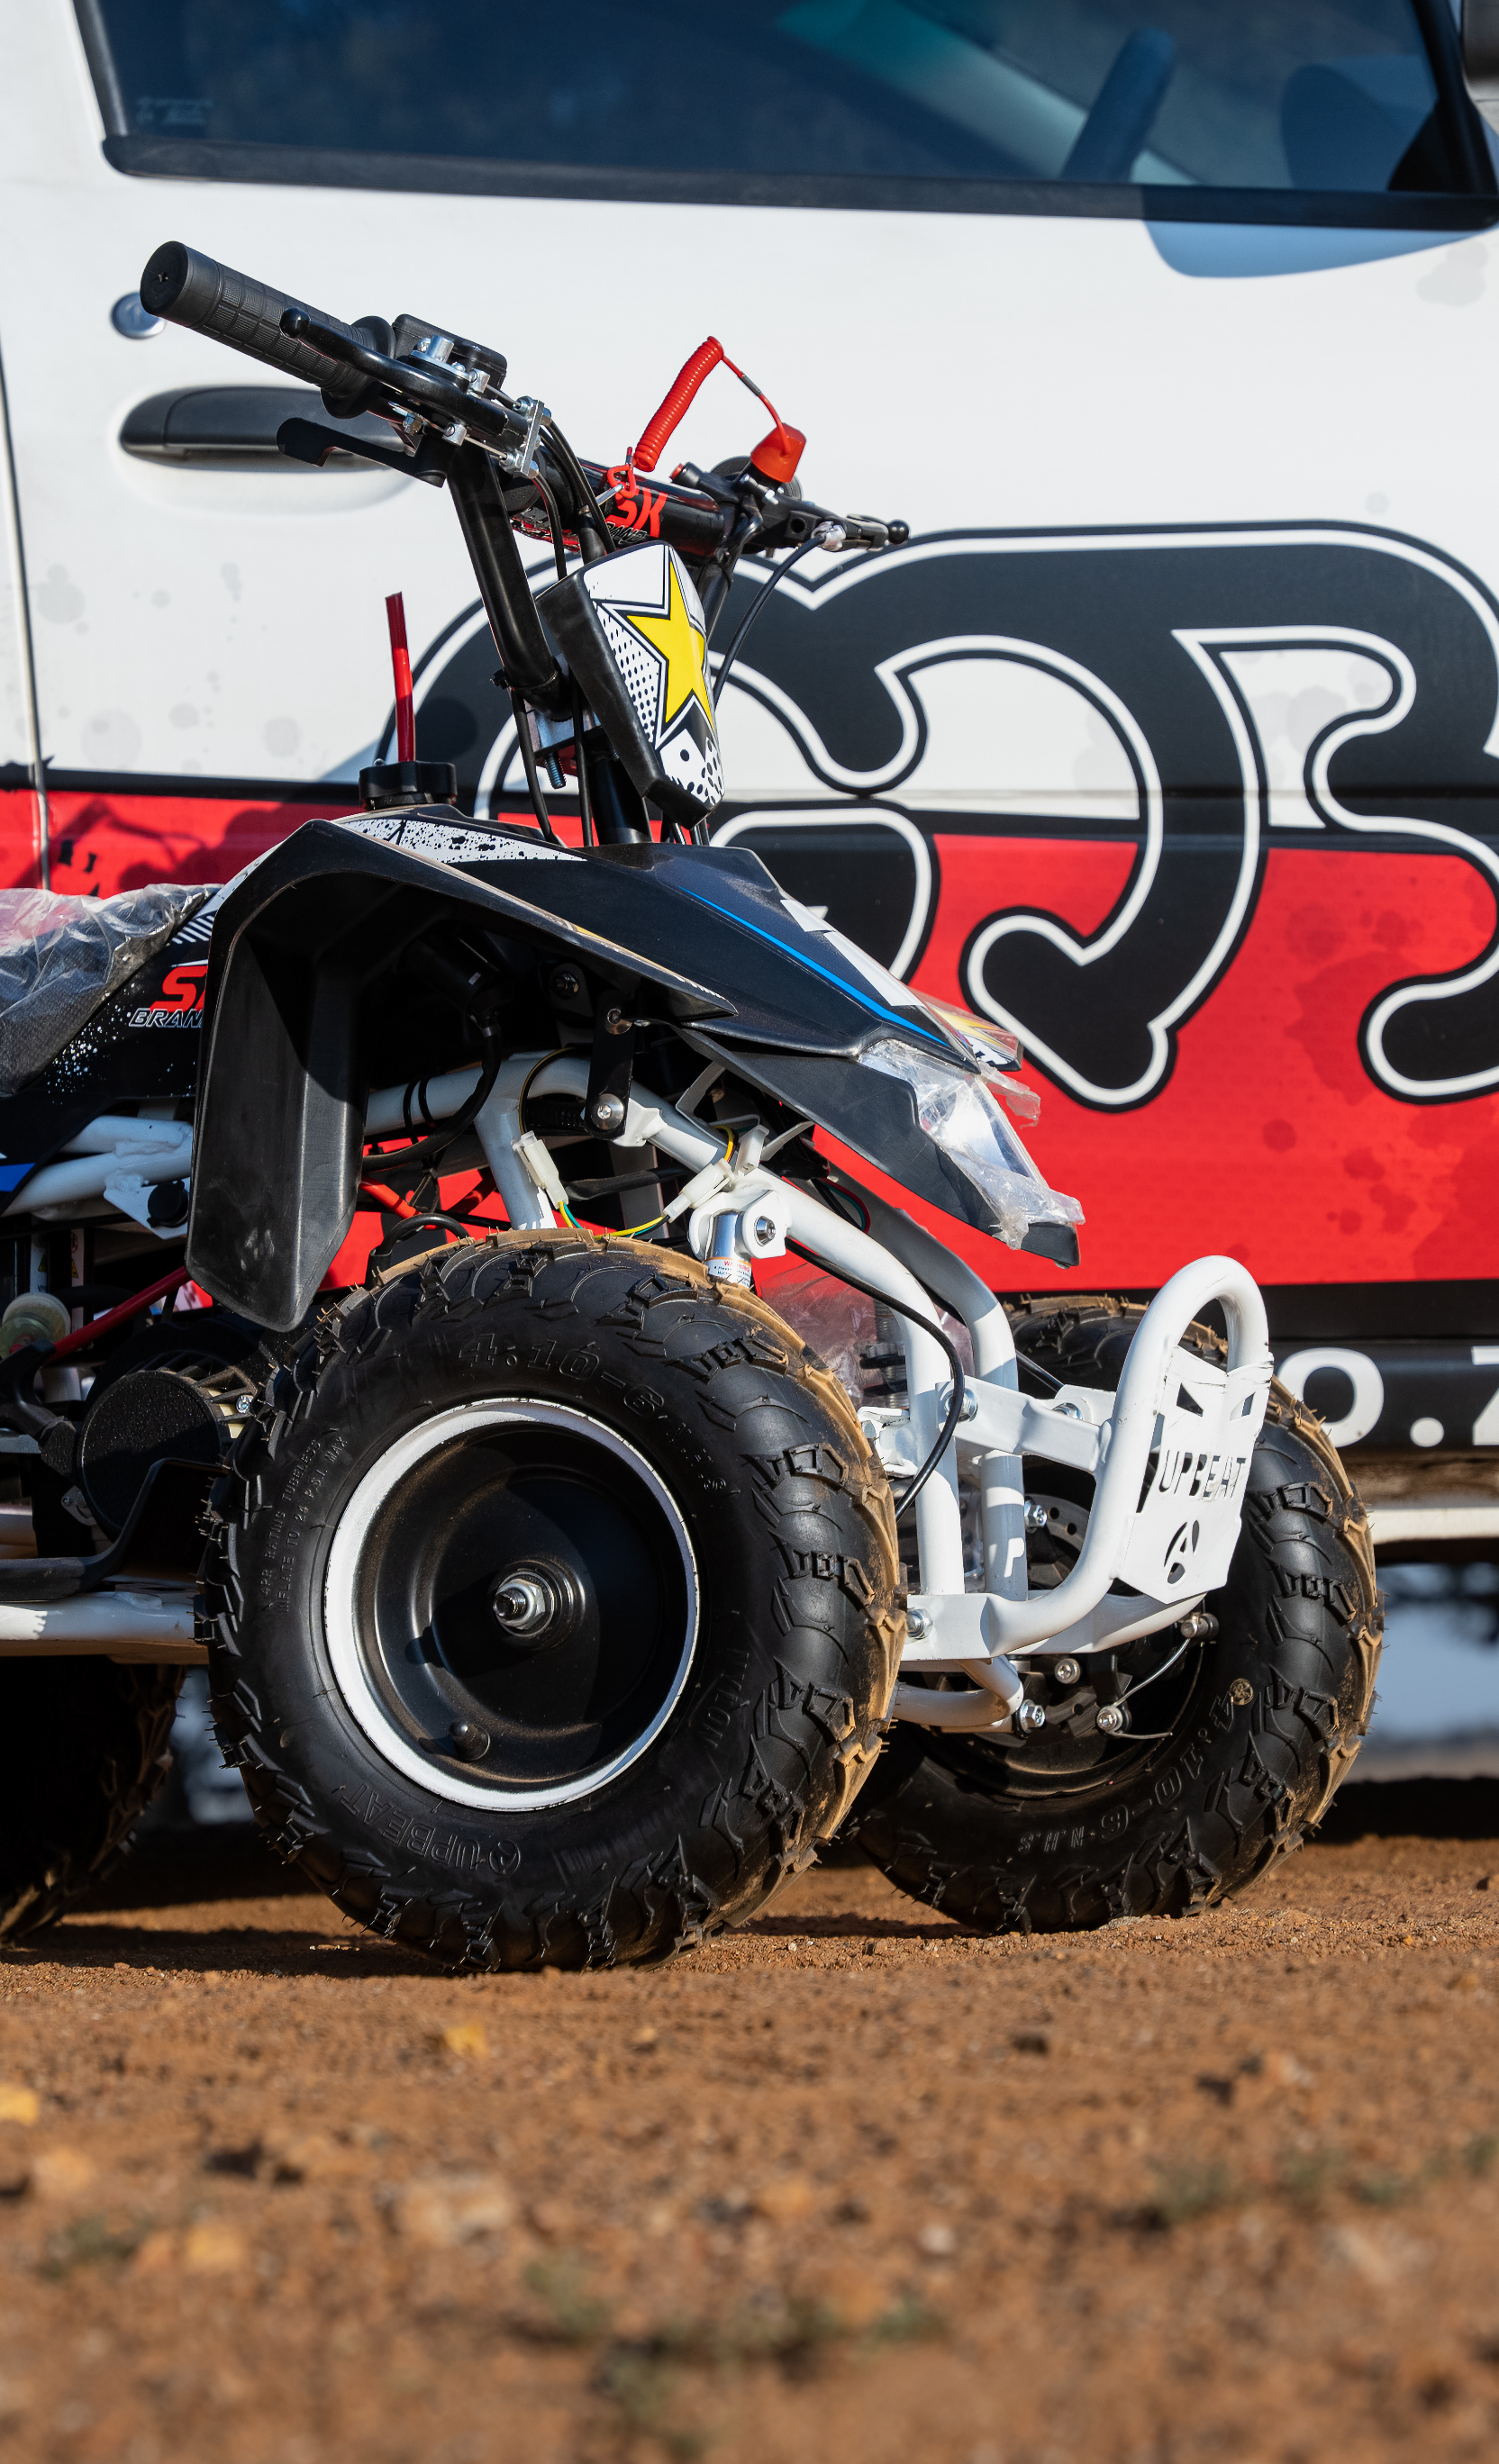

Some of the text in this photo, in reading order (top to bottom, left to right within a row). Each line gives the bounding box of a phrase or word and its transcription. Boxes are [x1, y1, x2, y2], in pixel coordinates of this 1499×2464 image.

[605, 487, 668, 538] SK
[150, 965, 208, 1012] S
[129, 1008, 204, 1028] BRAN
[458, 1333, 665, 1418] 4.10-6
[324, 1436, 348, 1463] MAX
[1158, 1449, 1248, 1499] UPBEAT
[265, 1511, 286, 1559] RATING
[282, 1439, 321, 1501] TUBELESS
[294, 1504, 309, 1523] 24
[285, 1531, 300, 1546] TO
[277, 1556, 295, 1613] INFLATE
[340, 1783, 481, 1871] UPBEAT
